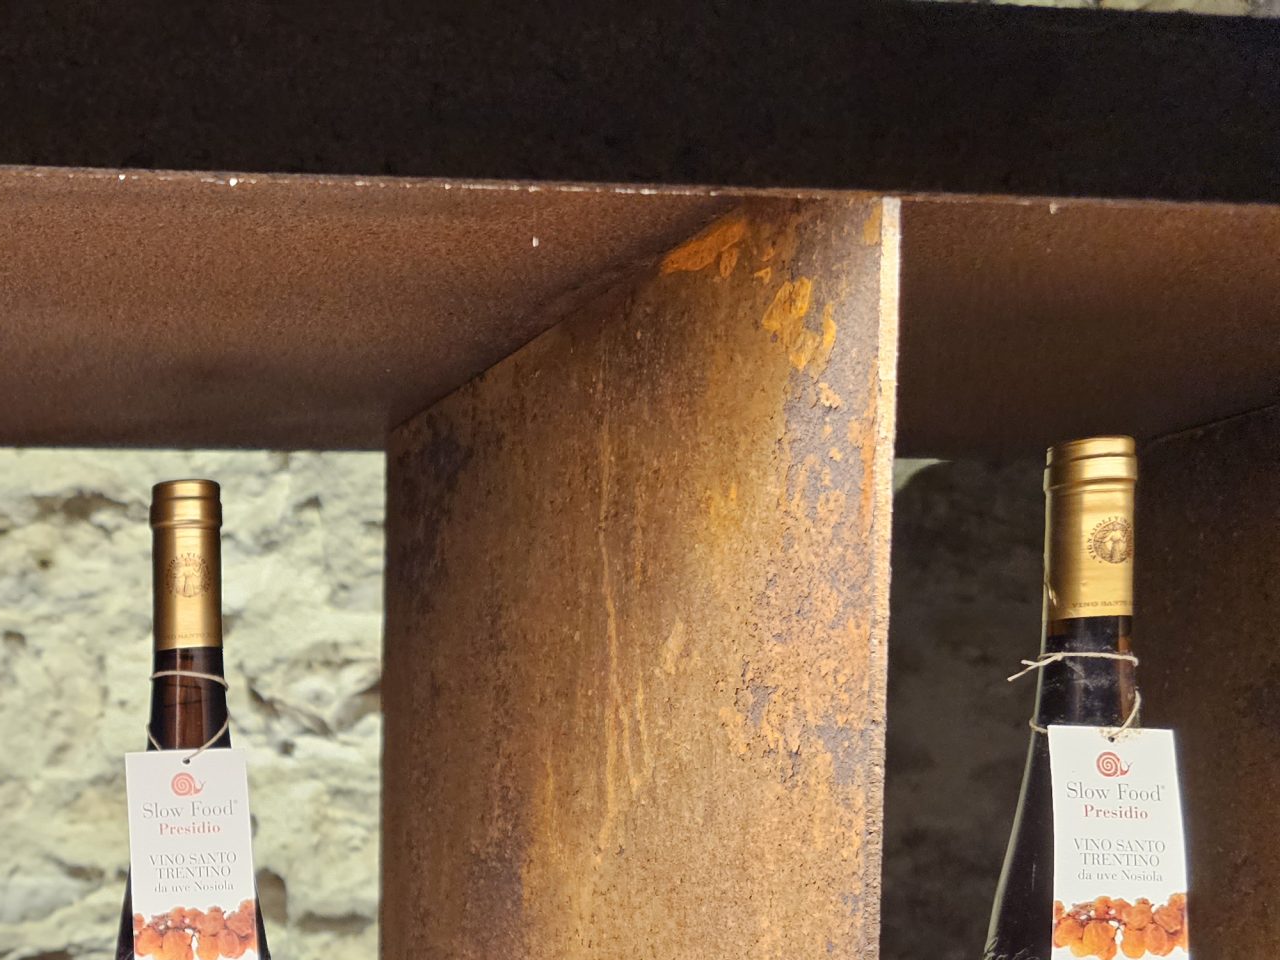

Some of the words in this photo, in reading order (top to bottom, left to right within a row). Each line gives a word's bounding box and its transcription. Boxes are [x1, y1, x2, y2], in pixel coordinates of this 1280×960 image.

[1066, 782, 1110, 799] Slow
[142, 802, 184, 819] Slow
[1084, 804, 1148, 819] Presidio
[159, 821, 220, 836] Presidio
[1074, 838, 1112, 851] VINO
[1116, 839, 1166, 853] SANTO
[149, 854, 185, 866] VINO
[189, 852, 237, 865] SANTO
[1080, 852, 1160, 867] TRENTINO
[156, 866, 231, 880] TRENTINO
[1077, 869, 1092, 880] da
[1096, 872, 1117, 880] uve
[1122, 870, 1163, 882] Nosiola
[154, 882, 167, 893] da
[172, 884, 191, 893] uve
[195, 880, 234, 892] Nosiola
